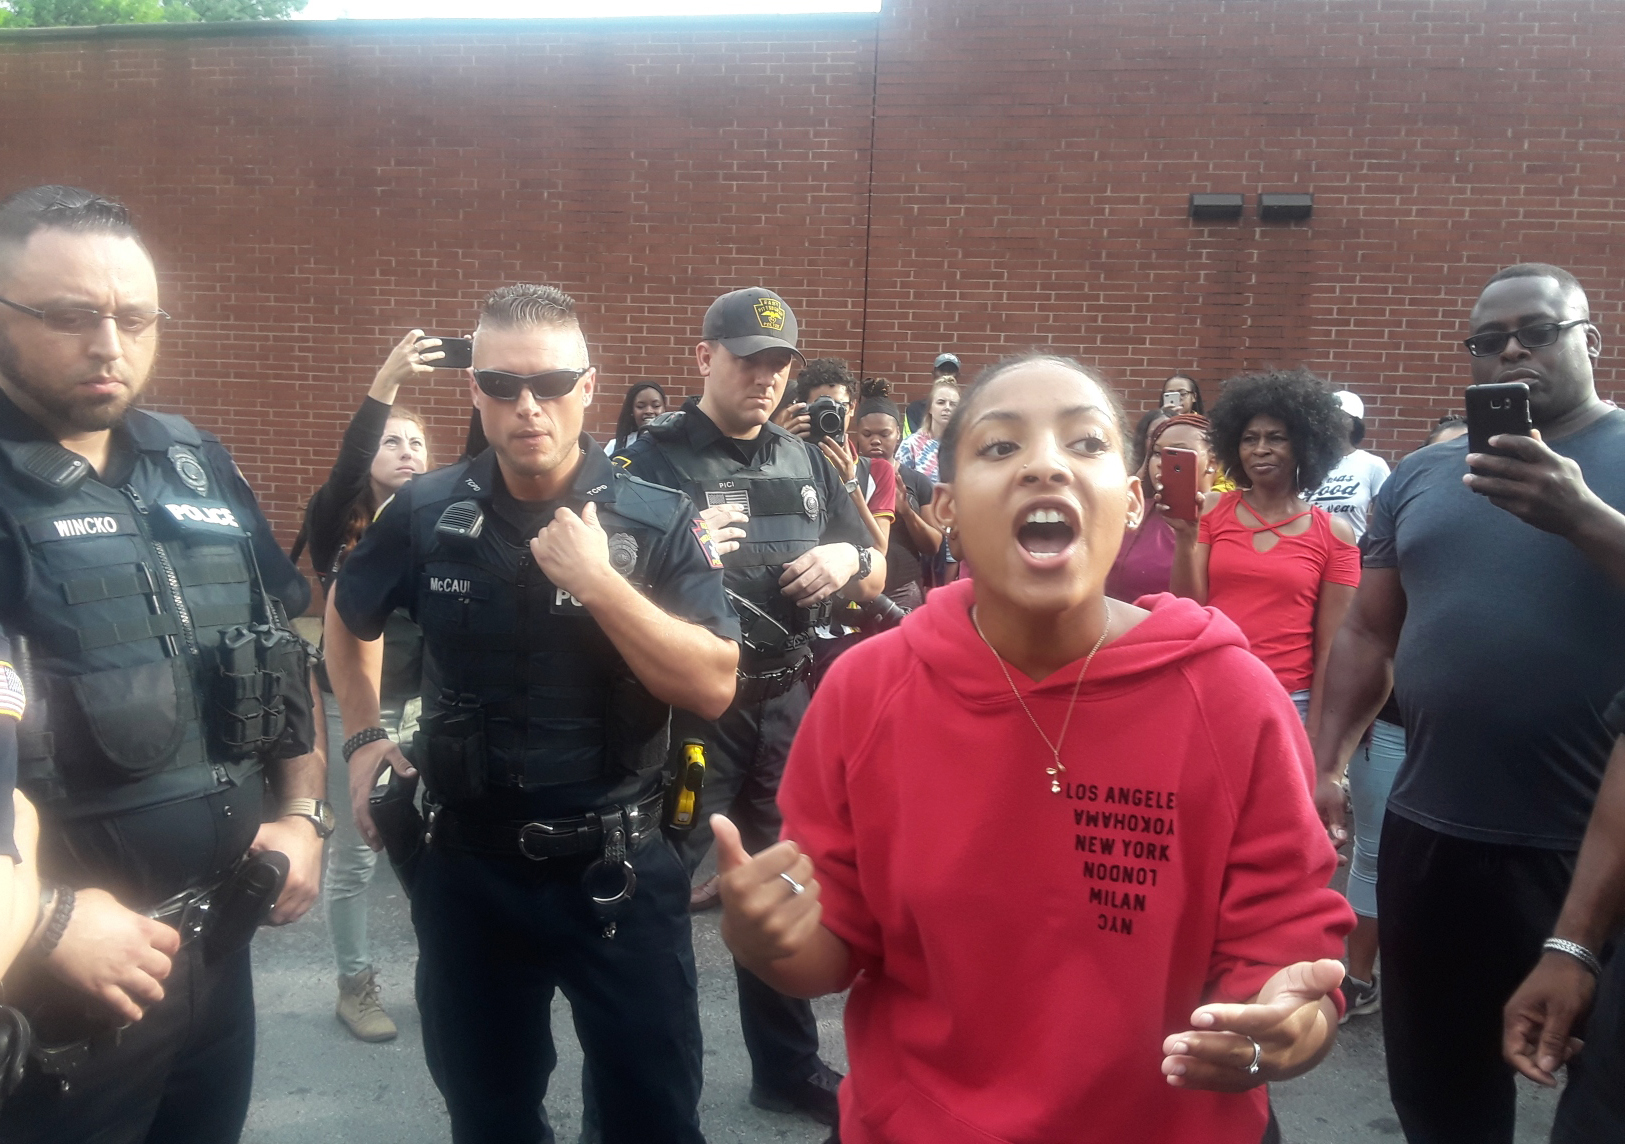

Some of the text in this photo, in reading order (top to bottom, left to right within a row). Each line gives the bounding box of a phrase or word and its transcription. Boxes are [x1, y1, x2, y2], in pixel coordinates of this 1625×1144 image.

[465, 477, 481, 492] TCPD
[586, 484, 608, 496] TCPD
[718, 481, 735, 489] PICI
[53, 516, 118, 537] WINCKO
[165, 504, 239, 528] POLICE
[1066, 782, 1175, 810] LOS ANGELE
[1074, 809, 1175, 836] YOKOHAMA
[1075, 834, 1171, 862] NEW YORK
[1083, 861, 1157, 887] LONDON
[1089, 887, 1146, 912] MILAN
[1097, 913, 1133, 935] NYC
